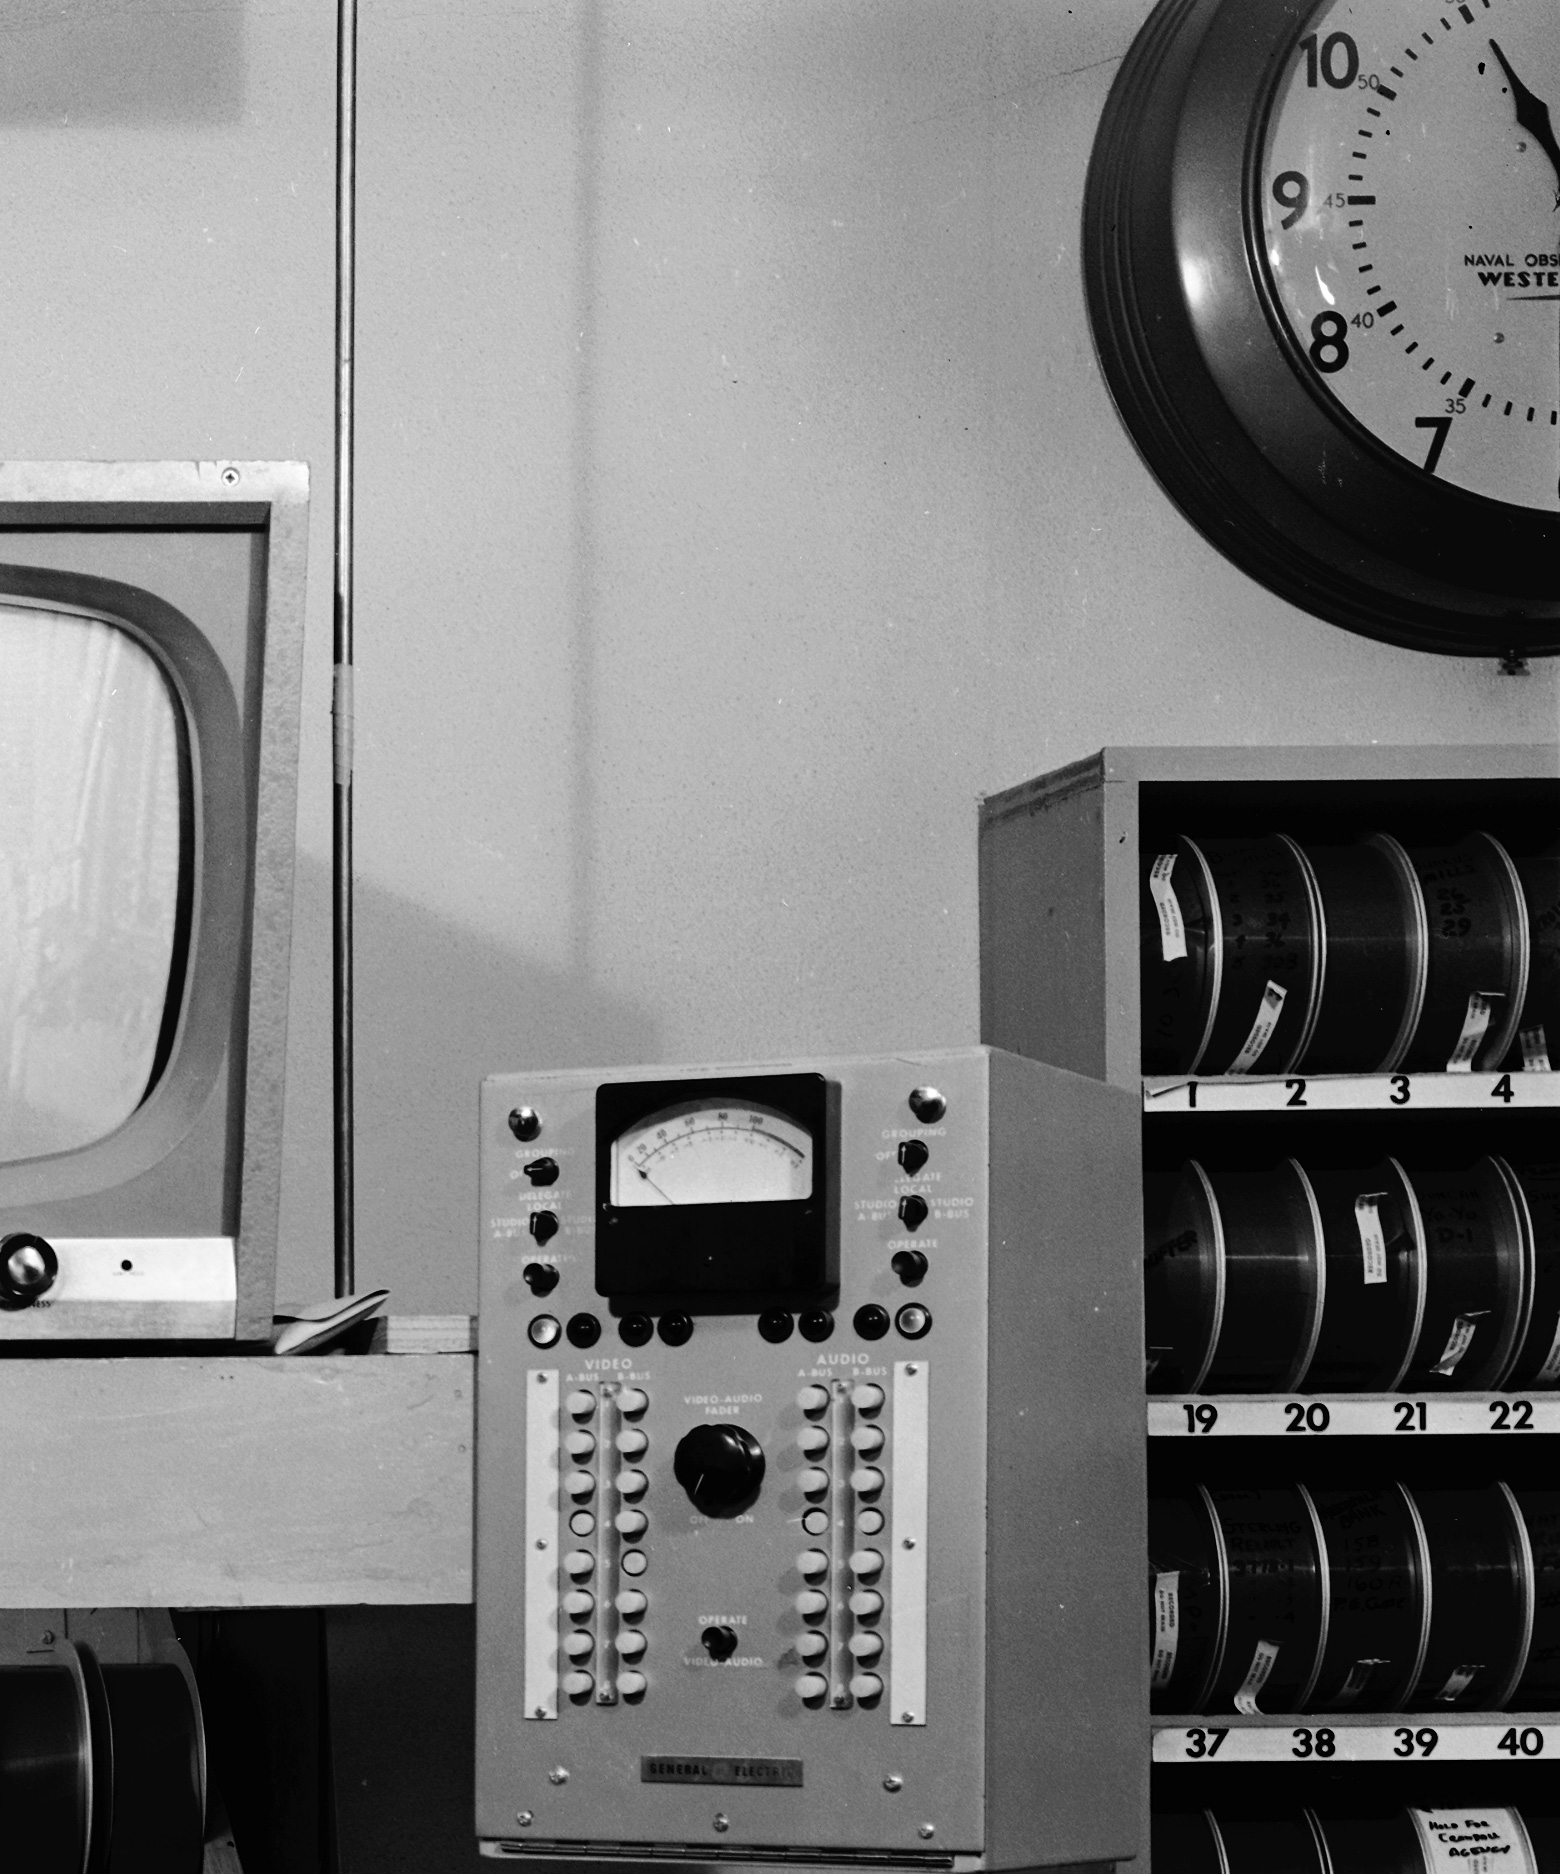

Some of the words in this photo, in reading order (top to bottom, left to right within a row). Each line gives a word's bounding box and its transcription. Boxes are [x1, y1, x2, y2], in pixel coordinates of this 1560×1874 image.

[1299, 31, 1360, 90] 10
[1358, 74, 1381, 91] 50
[1271, 170, 1309, 231] 9
[1323, 192, 1346, 208] 45
[1463, 253, 1514, 267] NAVAL
[1524, 253, 1560, 267] OBS
[1350, 311, 1375, 329] 40
[1309, 310, 1350, 373] 8
[1444, 397, 1467, 415] 35
[1415, 416, 1453, 474] 7
[1186, 1080, 1199, 1108] 1
[1285, 1078, 1307, 1107] 2
[1390, 1076, 1410, 1105] 3
[1491, 1073, 1514, 1103] 4
[881, 1127, 947, 1139] GROUPING
[893, 1184, 934, 1194] LOCAL
[853, 1200, 898, 1210] STUDIO
[930, 1197, 974, 1208] STUDIO
[886, 1238, 939, 1250] OPERATE
[584, 1357, 633, 1371] VIDEO
[816, 1352, 870, 1366] AUDIO
[683, 1393, 763, 1405] VIDEO-AUDIO
[705, 1405, 740, 1416] FADER
[1183, 1403, 1217, 1434] 19
[1285, 1402, 1330, 1433] 20
[1394, 1401, 1427, 1431] 21
[1490, 1401, 1534, 1430] 22
[697, 1614, 748, 1626] OPERATE
[1185, 1727, 1230, 1759] 37
[1292, 1727, 1336, 1758] 38
[1393, 1726, 1439, 1757] 39
[1498, 1726, 1544, 1756] 40
[649, 1763, 708, 1775] GENERAL
[1429, 1820, 1458, 1830] HOLD
[1465, 1820, 1490, 1828] FOR
